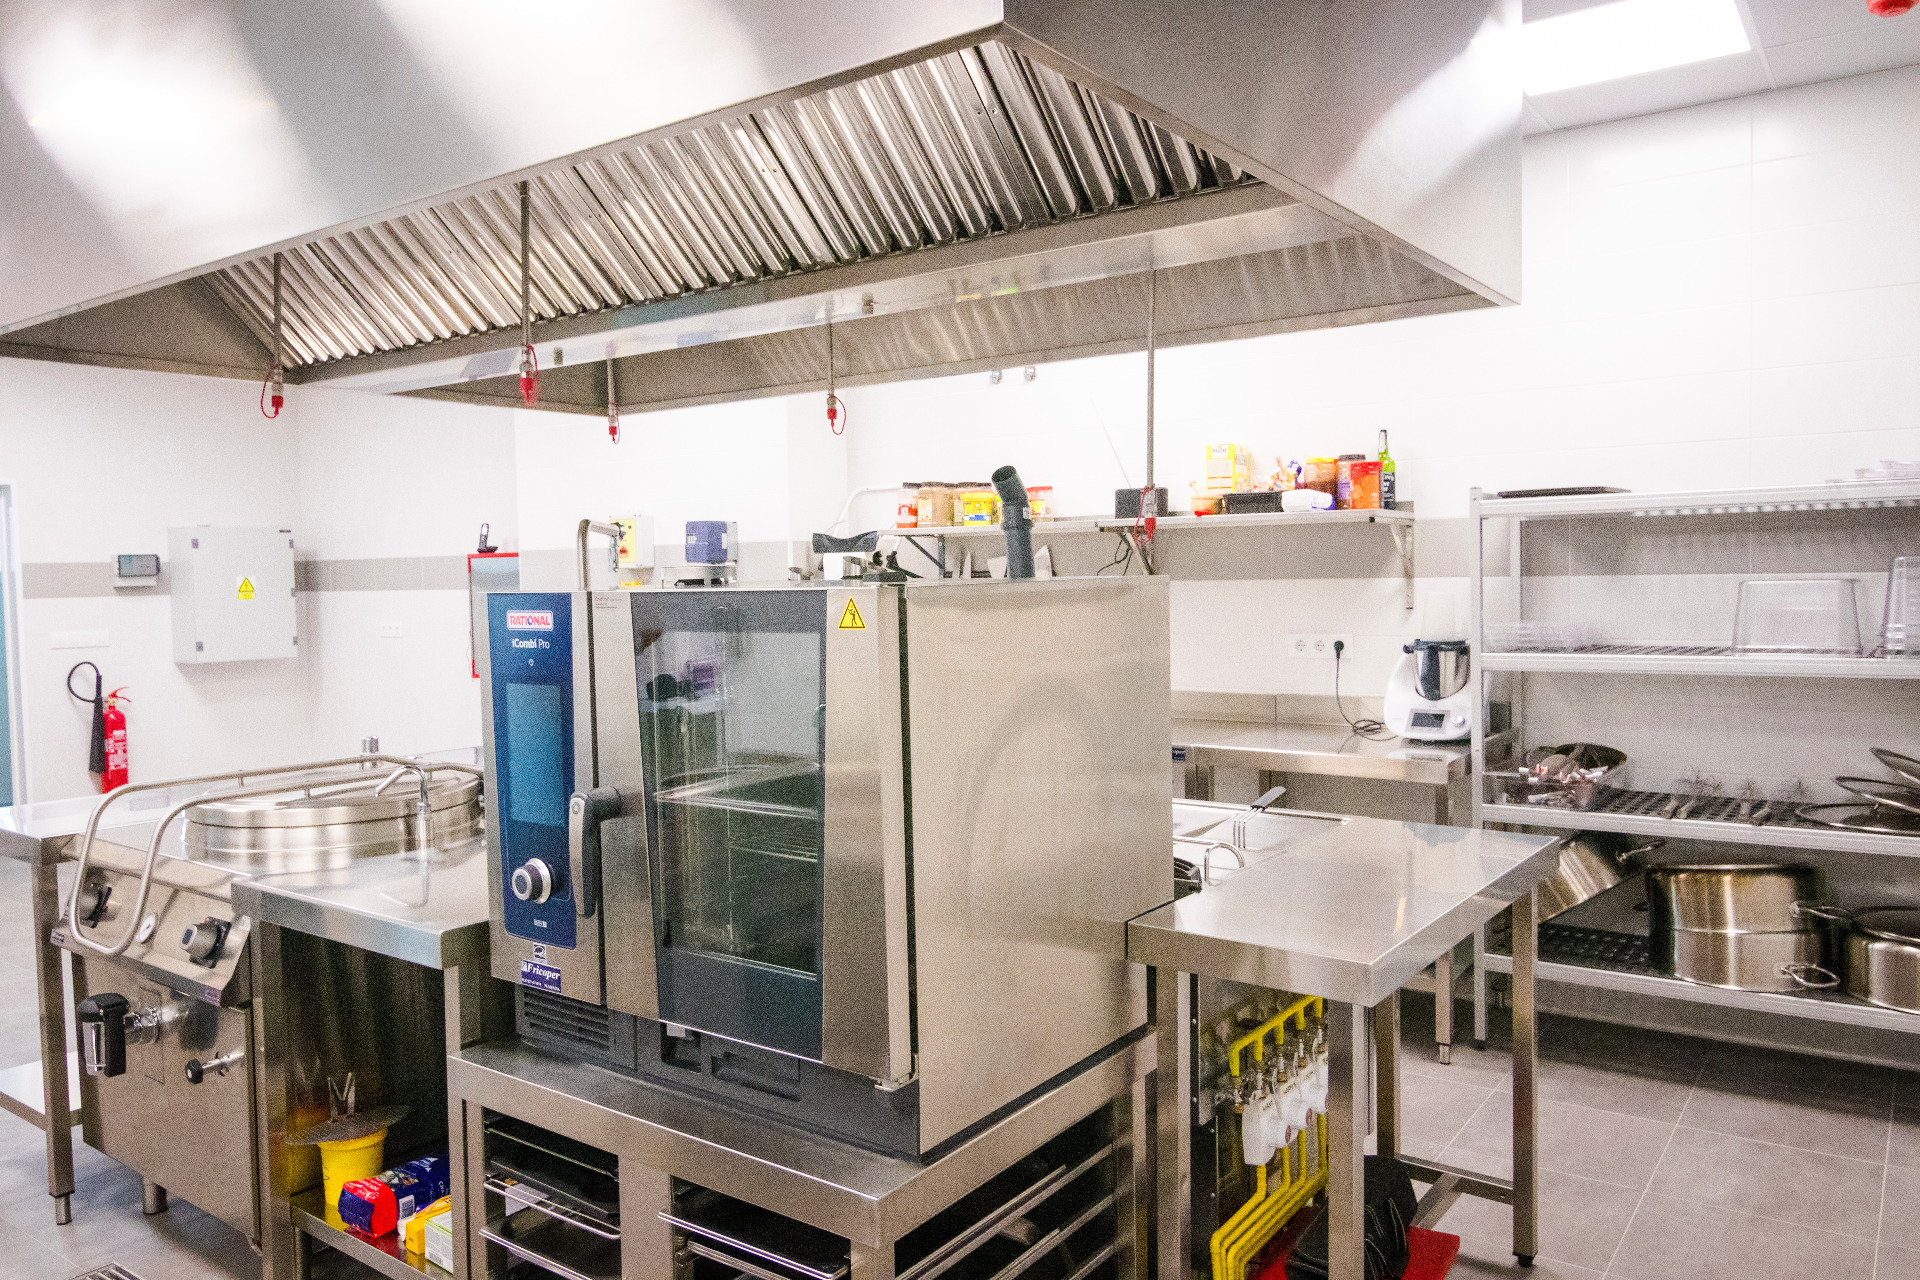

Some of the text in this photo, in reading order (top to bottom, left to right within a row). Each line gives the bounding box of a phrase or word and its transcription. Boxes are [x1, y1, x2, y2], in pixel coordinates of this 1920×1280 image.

[510, 615, 551, 626] RATIONAL
[512, 638, 550, 649] iCombi Pro
[527, 962, 560, 980] Fricoper
